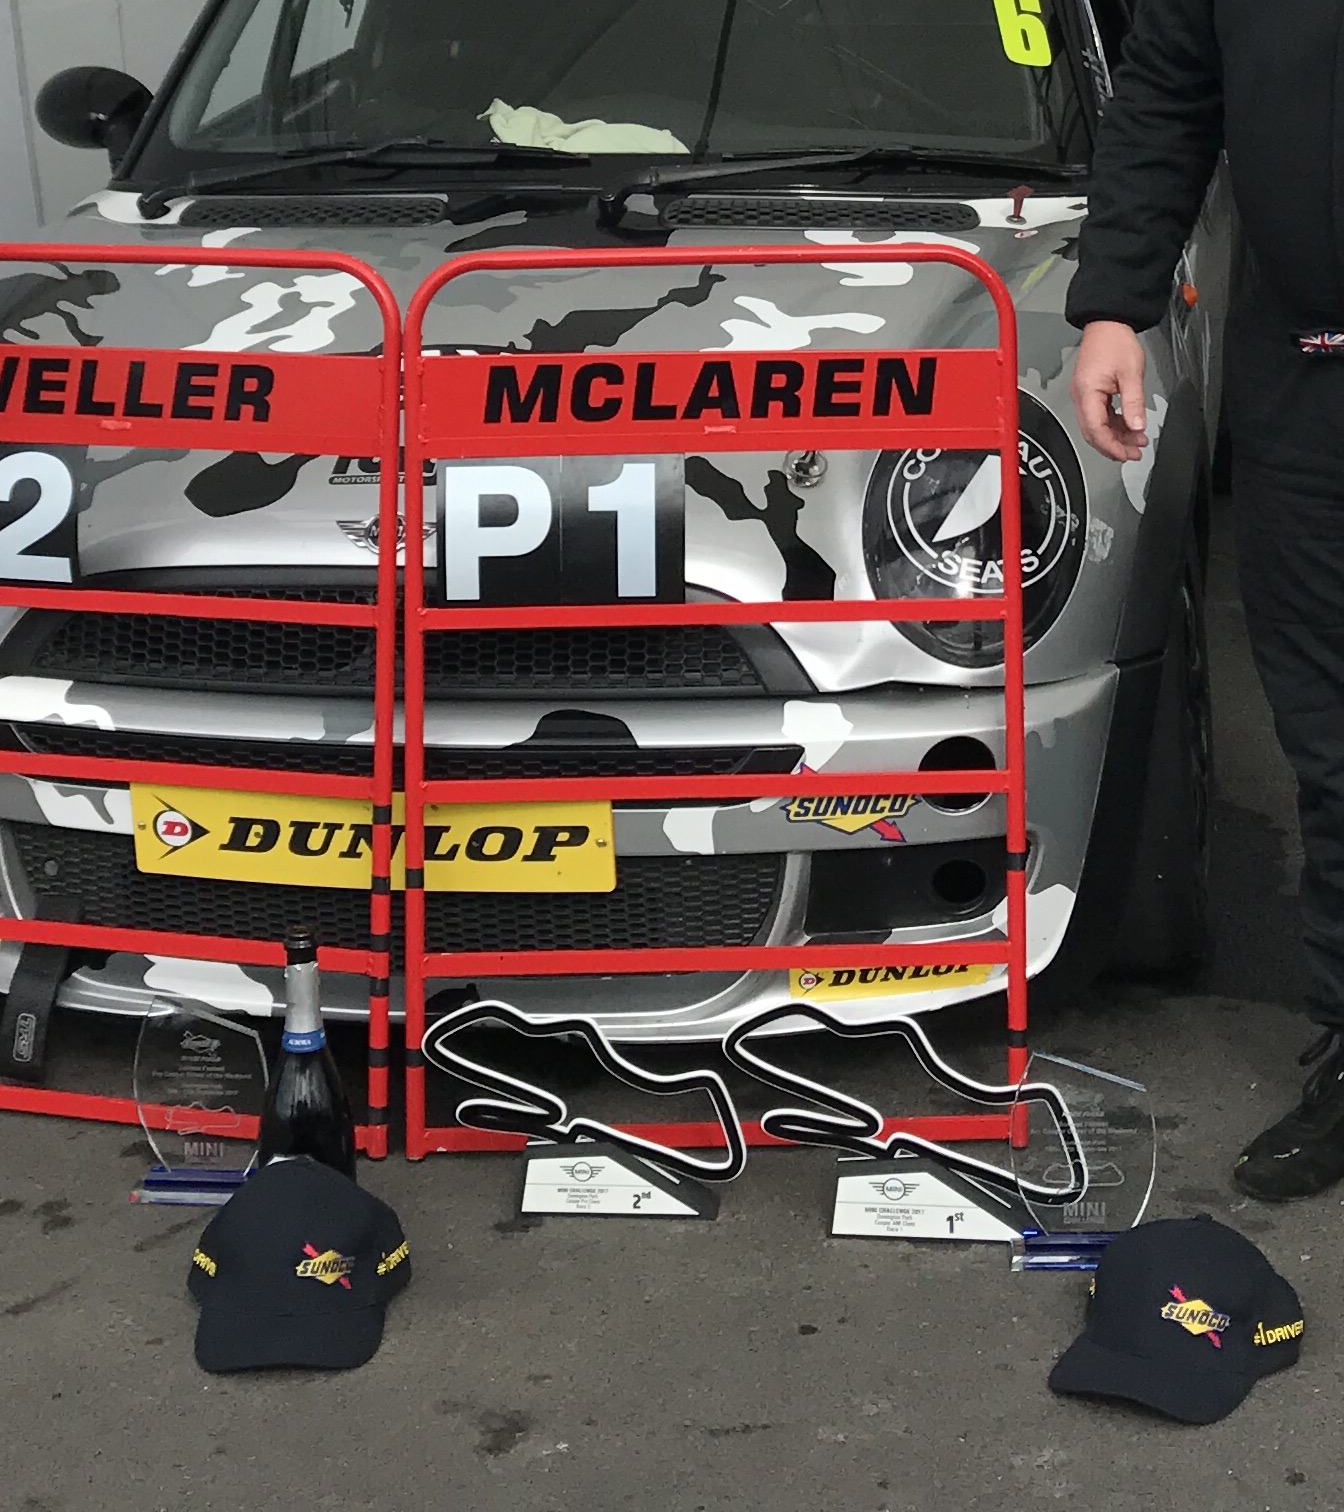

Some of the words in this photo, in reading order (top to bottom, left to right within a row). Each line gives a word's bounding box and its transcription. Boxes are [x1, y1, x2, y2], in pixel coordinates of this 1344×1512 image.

[482, 357, 938, 425] MCLAREN
[444, 462, 658, 601] P1
[937, 548, 1040, 585] SEAS
[794, 793, 908, 817] SUNOCO
[218, 815, 590, 863] DUNLOP
[184, 1142, 224, 1157] MINI
[632, 1191, 651, 1209] 2nd
[1063, 1201, 1106, 1217] MINI
[946, 1211, 964, 1234] 1st
[300, 1256, 355, 1275] SUNOCO
[1164, 1304, 1231, 1331] SUNOCO
